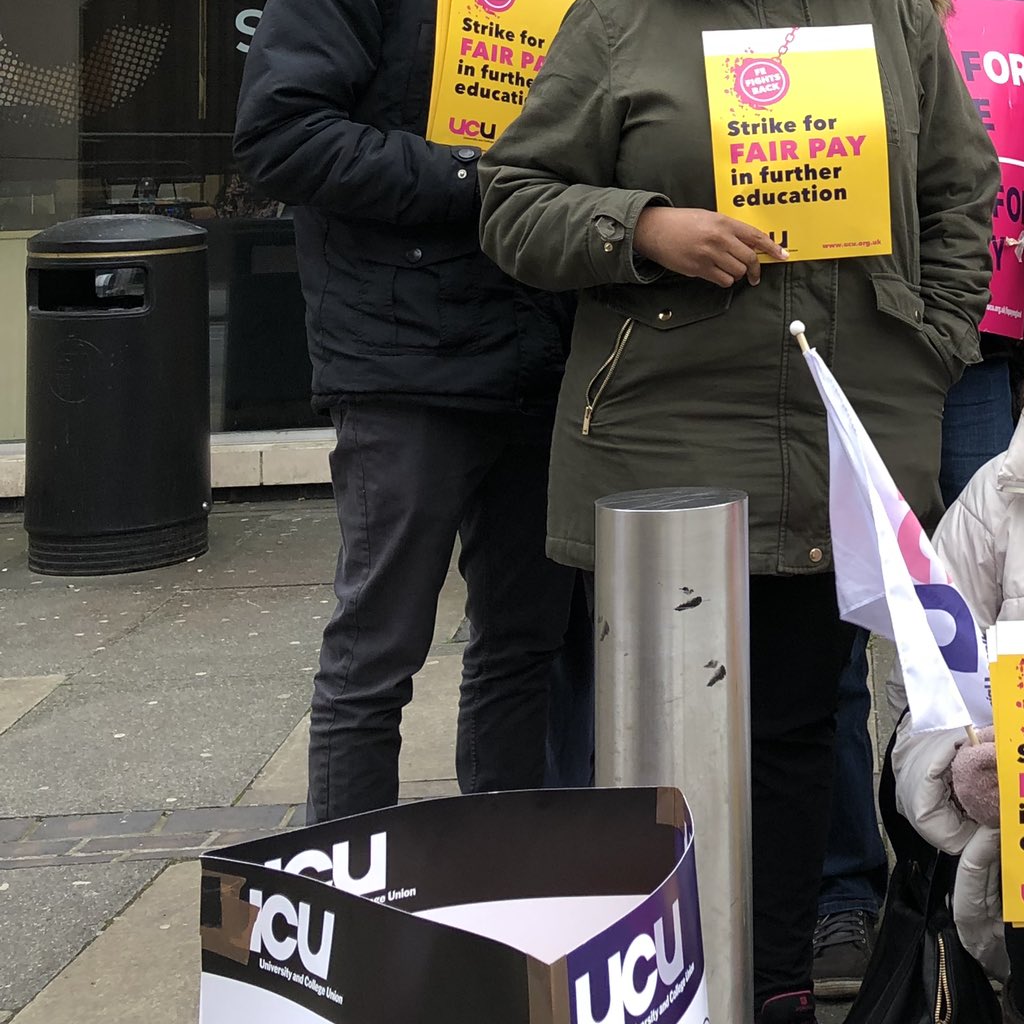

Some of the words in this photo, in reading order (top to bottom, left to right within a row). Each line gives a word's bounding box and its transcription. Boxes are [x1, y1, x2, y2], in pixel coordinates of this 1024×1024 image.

[462, 16, 516, 42] Strike
[520, 30, 546, 49] for
[460, 38, 514, 66] FAIR
[521, 51, 546, 73] PA
[457, 59, 475, 77] in
[481, 64, 533, 89] furthe
[745, 73, 782, 88] FIGHTS
[753, 67, 766, 76] FE
[454, 81, 527, 106] educati
[751, 83, 780, 96] BACK
[727, 117, 797, 137] Strike
[802, 115, 837, 132] for
[730, 140, 799, 164] FAIR
[808, 135, 867, 159] PAY
[731, 168, 753, 186] in
[759, 164, 842, 184] further
[732, 184, 848, 207] education
[387, 887, 417, 902] Union
[259, 958, 292, 982] University
[292, 970, 304, 984] and
[304, 974, 326, 996] College
[326, 986, 344, 1005] Union
